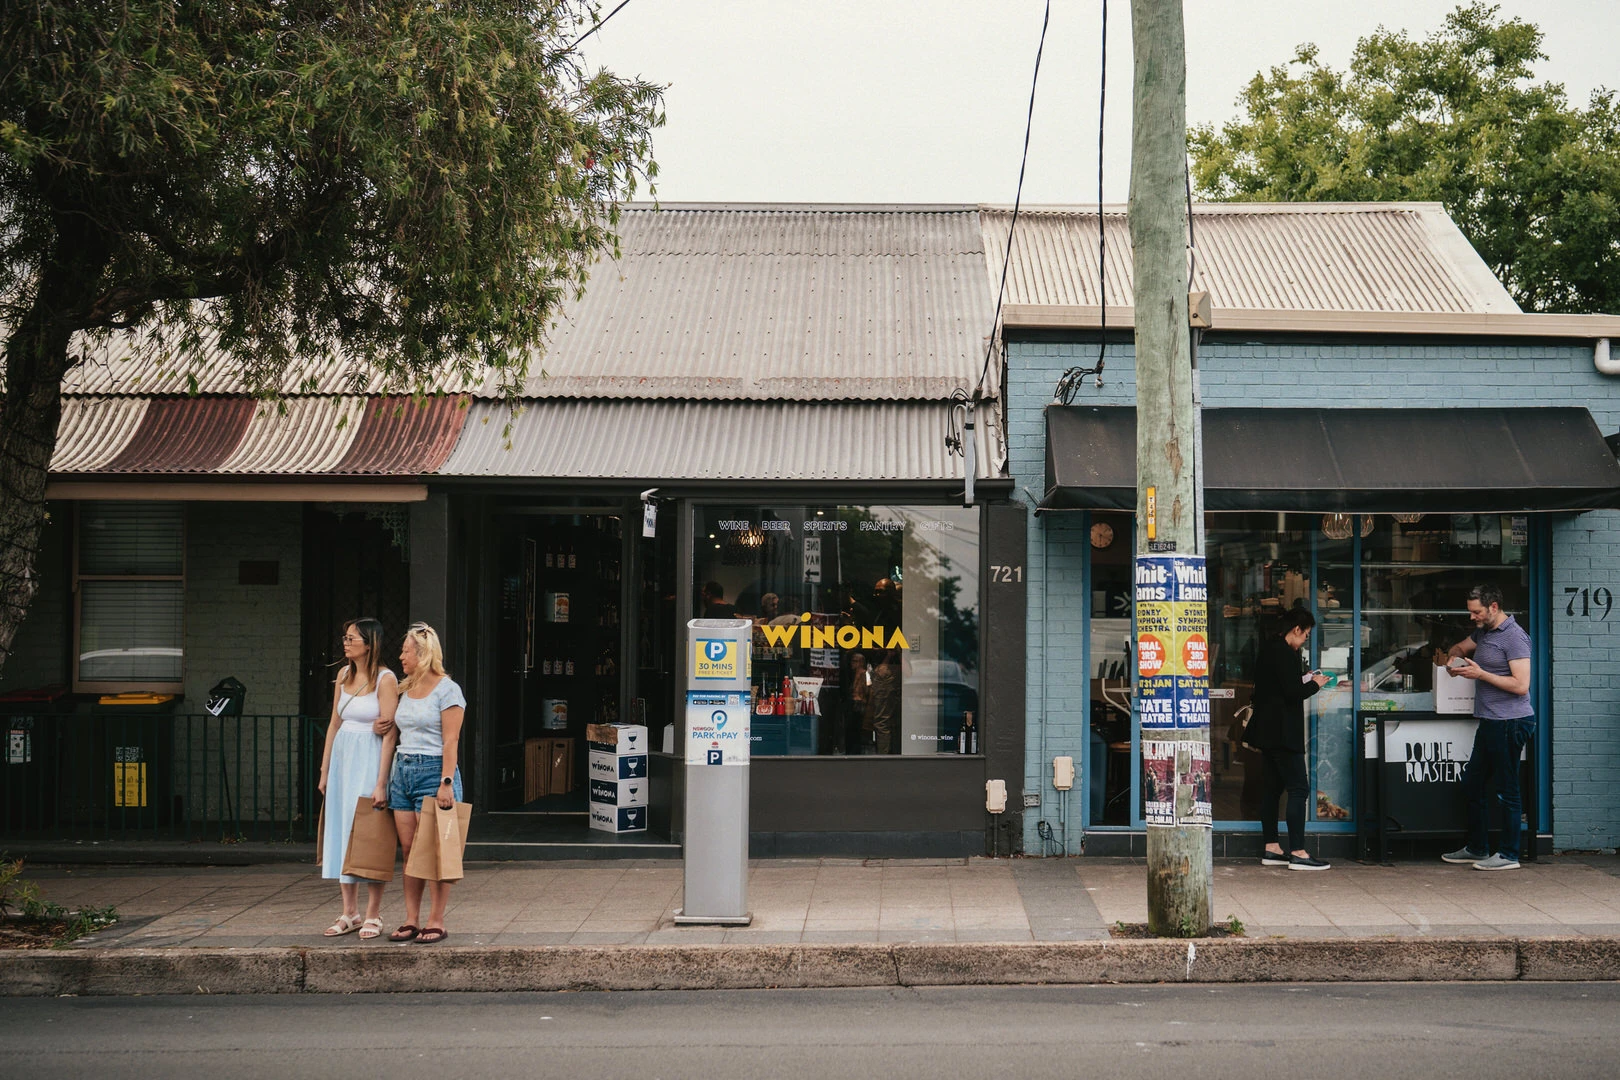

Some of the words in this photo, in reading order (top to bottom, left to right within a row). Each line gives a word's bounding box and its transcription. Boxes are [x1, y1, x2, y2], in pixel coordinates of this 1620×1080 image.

[718, 520, 750, 531] WINE
[761, 520, 791, 531] BEER
[803, 521, 848, 531] SPIRITS
[859, 521, 906, 532] PANTRY
[919, 521, 954, 531] GIFTS
[990, 565, 1022, 583] 721
[1136, 586, 1167, 601] ams
[1564, 586, 1613, 621] 719
[1184, 609, 1206, 617] SYDNEY
[1178, 616, 1207, 625] SYMPHON
[710, 641, 724, 659] P
[1186, 641, 1207, 651] FINAL
[1141, 651, 1157, 660] 3RD
[1190, 651, 1204, 660] 3RD
[1139, 660, 1162, 670] SHOW
[1186, 660, 1207, 670] SHOW
[1153, 678, 1172, 688] JAN
[1178, 679, 1194, 688] SAT
[1201, 679, 1209, 688] JA
[1140, 698, 1173, 713] TATE
[1179, 712, 1210, 724] THEATR
[1405, 741, 1454, 761] DOUBLE
[710, 751, 720, 764] P
